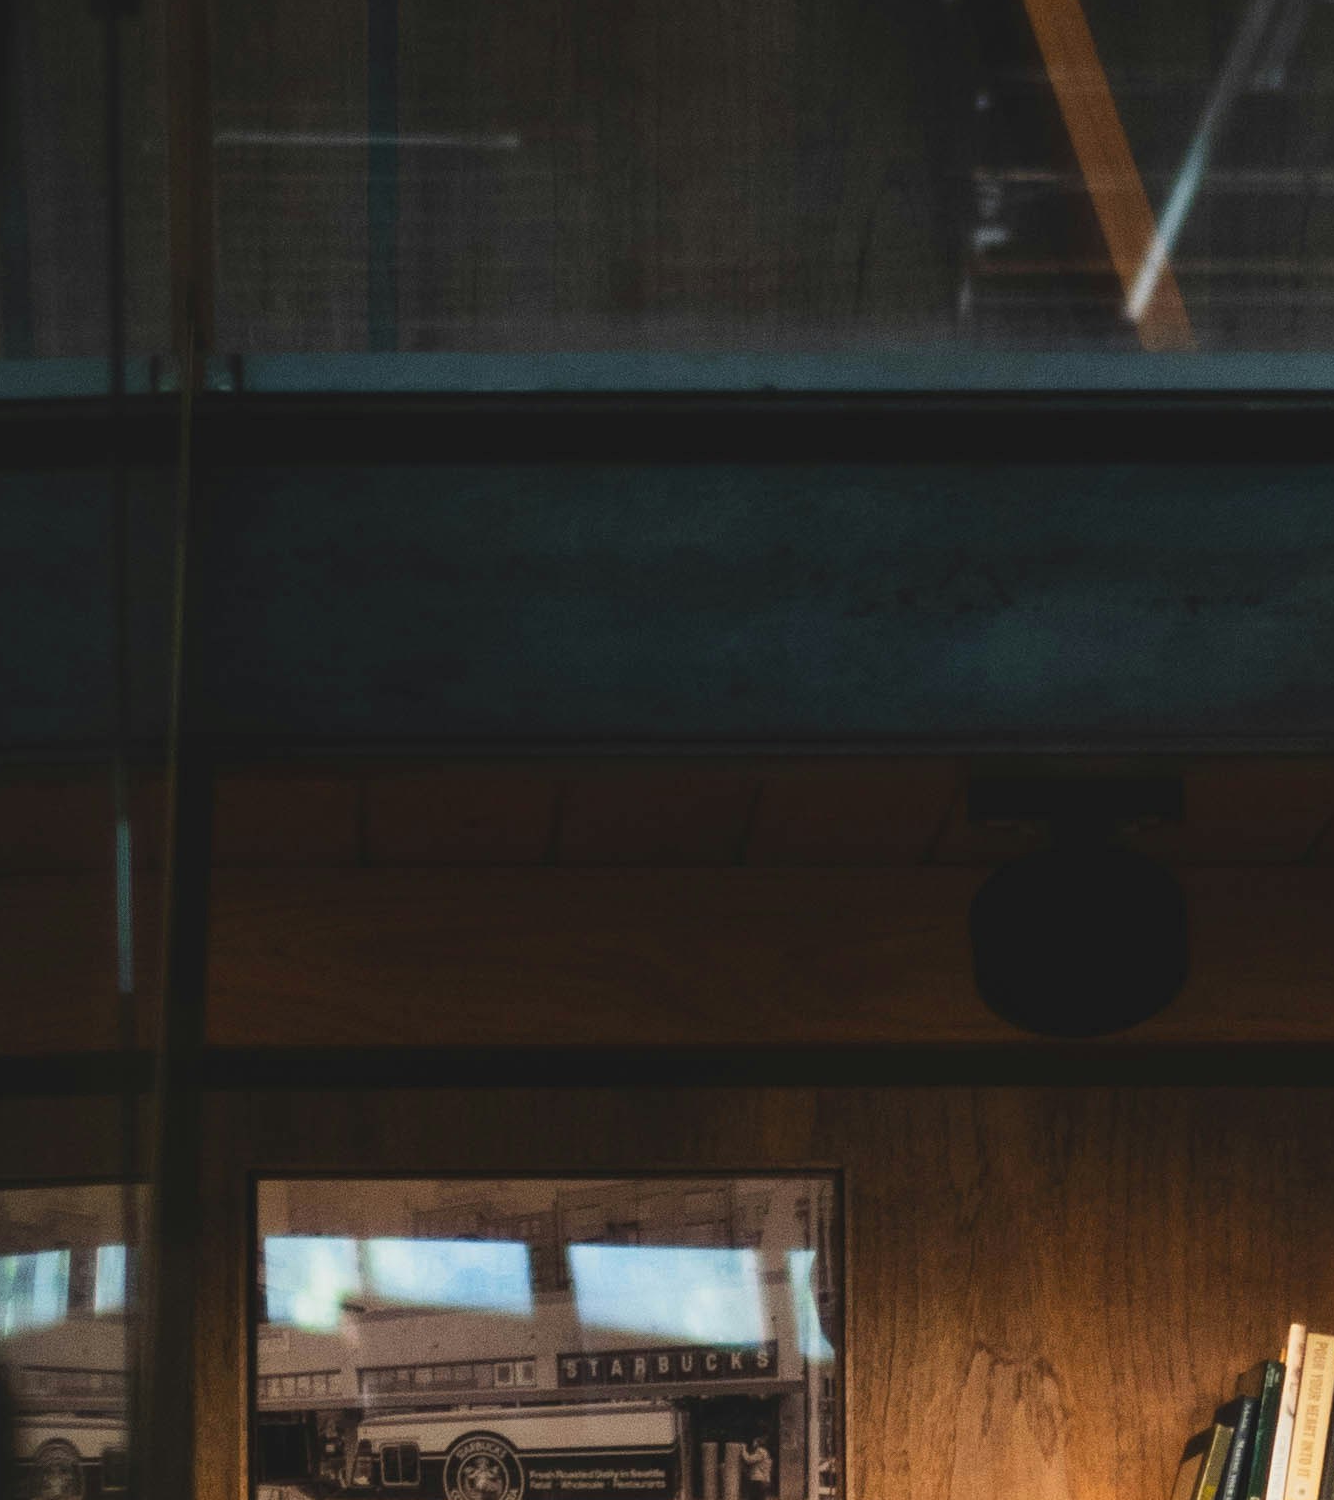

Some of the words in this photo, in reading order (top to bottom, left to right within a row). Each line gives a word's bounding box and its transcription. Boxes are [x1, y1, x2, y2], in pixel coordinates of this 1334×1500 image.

[561, 1350, 769, 1379] STARBUCKS
[1310, 1340, 1330, 1369] POUR
[1306, 1368, 1326, 1399] YOUR
[1300, 1399, 1322, 1438] HEART
[1296, 1439, 1316, 1466] INTO
[1296, 1467, 1311, 1478] IT
